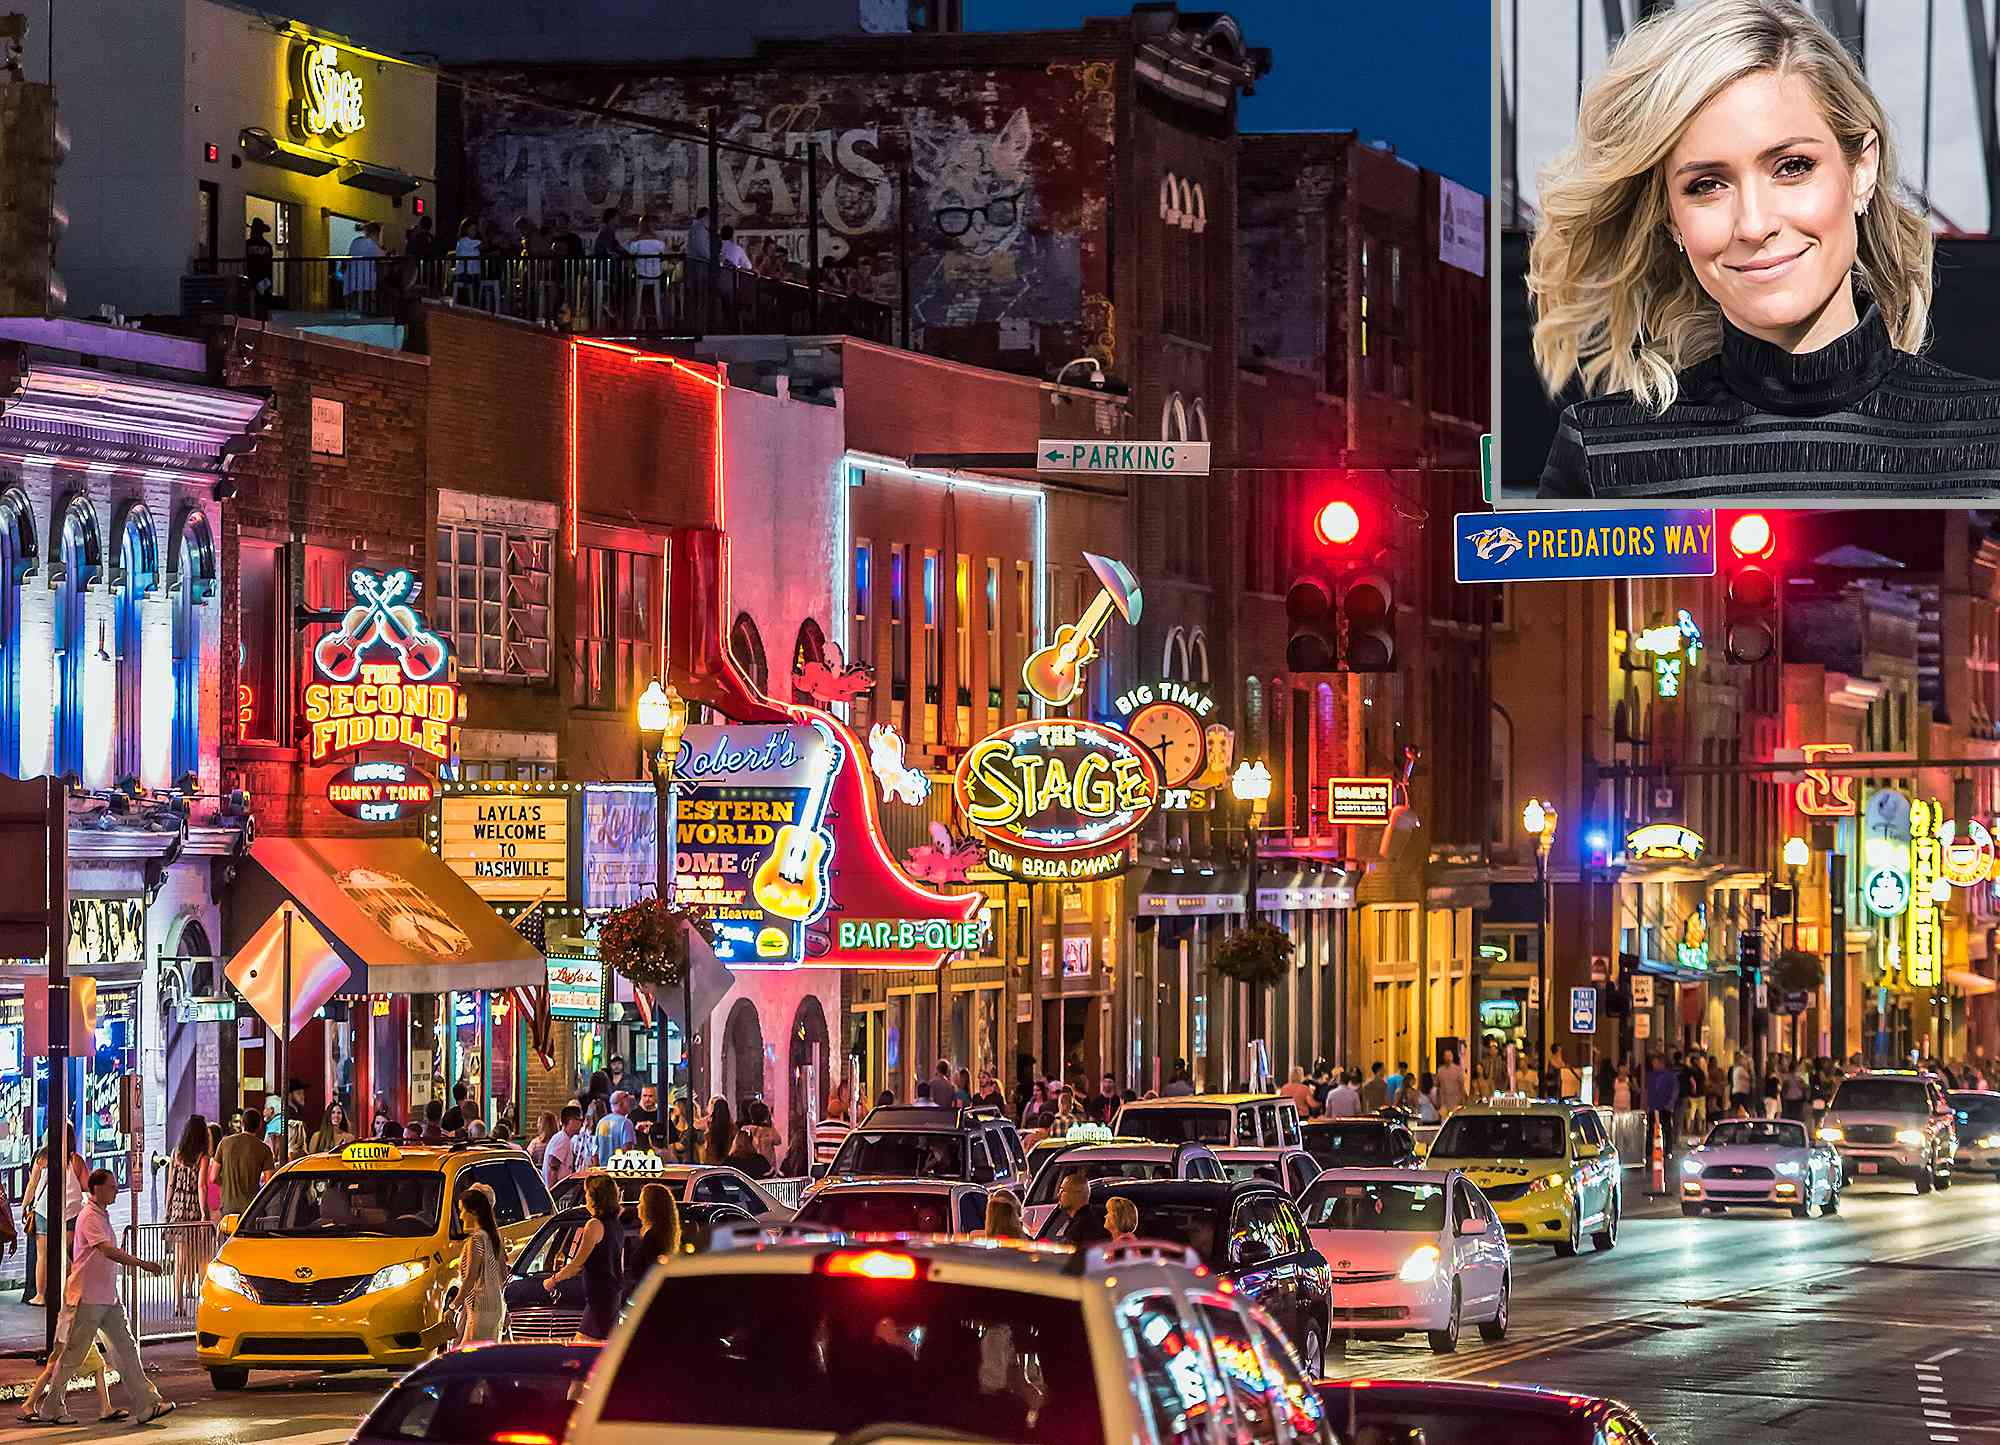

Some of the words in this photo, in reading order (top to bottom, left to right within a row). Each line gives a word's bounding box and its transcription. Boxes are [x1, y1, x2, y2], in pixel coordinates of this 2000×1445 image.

[1071, 444, 1175, 470] PARKING
[1526, 525, 1655, 559] PREDATORS
[1663, 524, 1712, 554] WAY
[360, 664, 401, 684] THE
[305, 684, 453, 722] SECOND
[1115, 685, 1153, 716] BIG
[1158, 682, 1214, 717] TIME
[312, 715, 448, 760] FIDDLE
[657, 729, 799, 786] Robert's
[329, 785, 382, 801] HONKY
[385, 785, 431, 801] TONK
[968, 739, 1153, 827] STAGE
[360, 803, 399, 821] CITY
[477, 805, 541, 822] LAYLA'S
[676, 799, 794, 822] ESTERN
[473, 824, 547, 840] WELCOME
[676, 823, 775, 845] WORLD
[499, 843, 517, 858] TO
[475, 861, 549, 877] NASHVILLE
[676, 852, 738, 873] OME
[741, 851, 761, 878] of
[988, 848, 1013, 872] ON
[1022, 850, 1123, 877] BROADWAY
[719, 906, 763, 920] Heaven
[839, 921, 980, 950] BAR-B-QUE
[350, 1146, 391, 1158] YELLOW
[611, 1158, 656, 1170] TAXI
